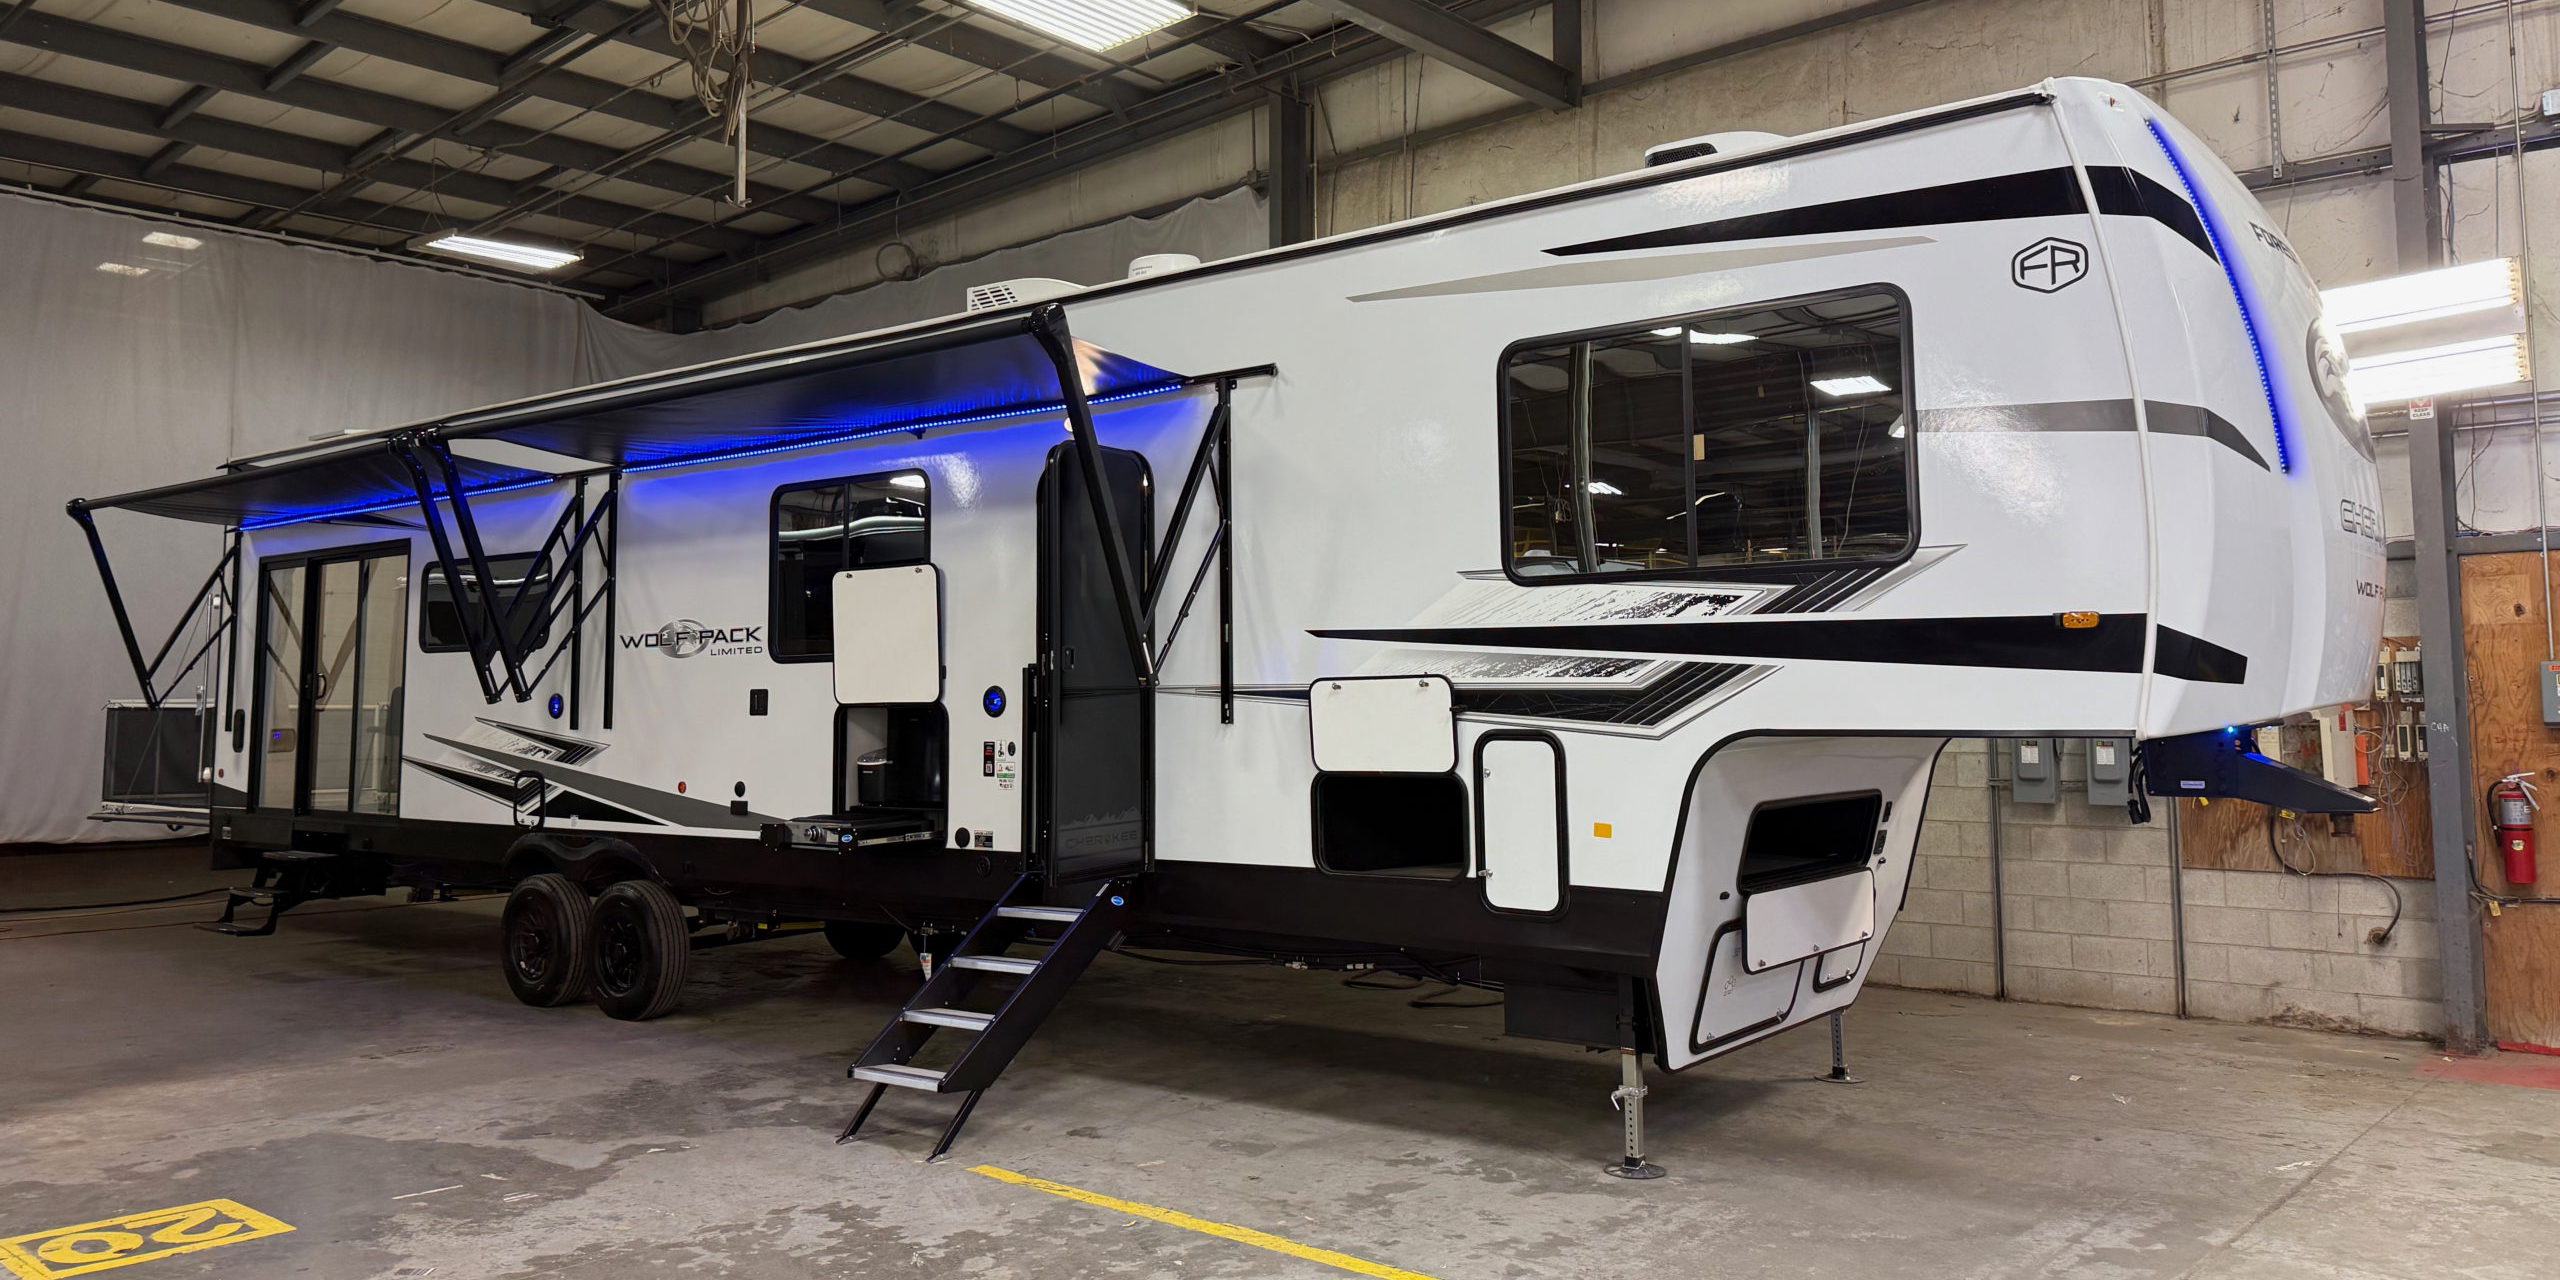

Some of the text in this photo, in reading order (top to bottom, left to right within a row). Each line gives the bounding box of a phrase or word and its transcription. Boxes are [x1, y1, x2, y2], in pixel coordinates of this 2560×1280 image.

[2019, 244, 2080, 285] FR
[619, 626, 763, 649] WOLF PACK
[710, 646, 763, 656] LIMITED
